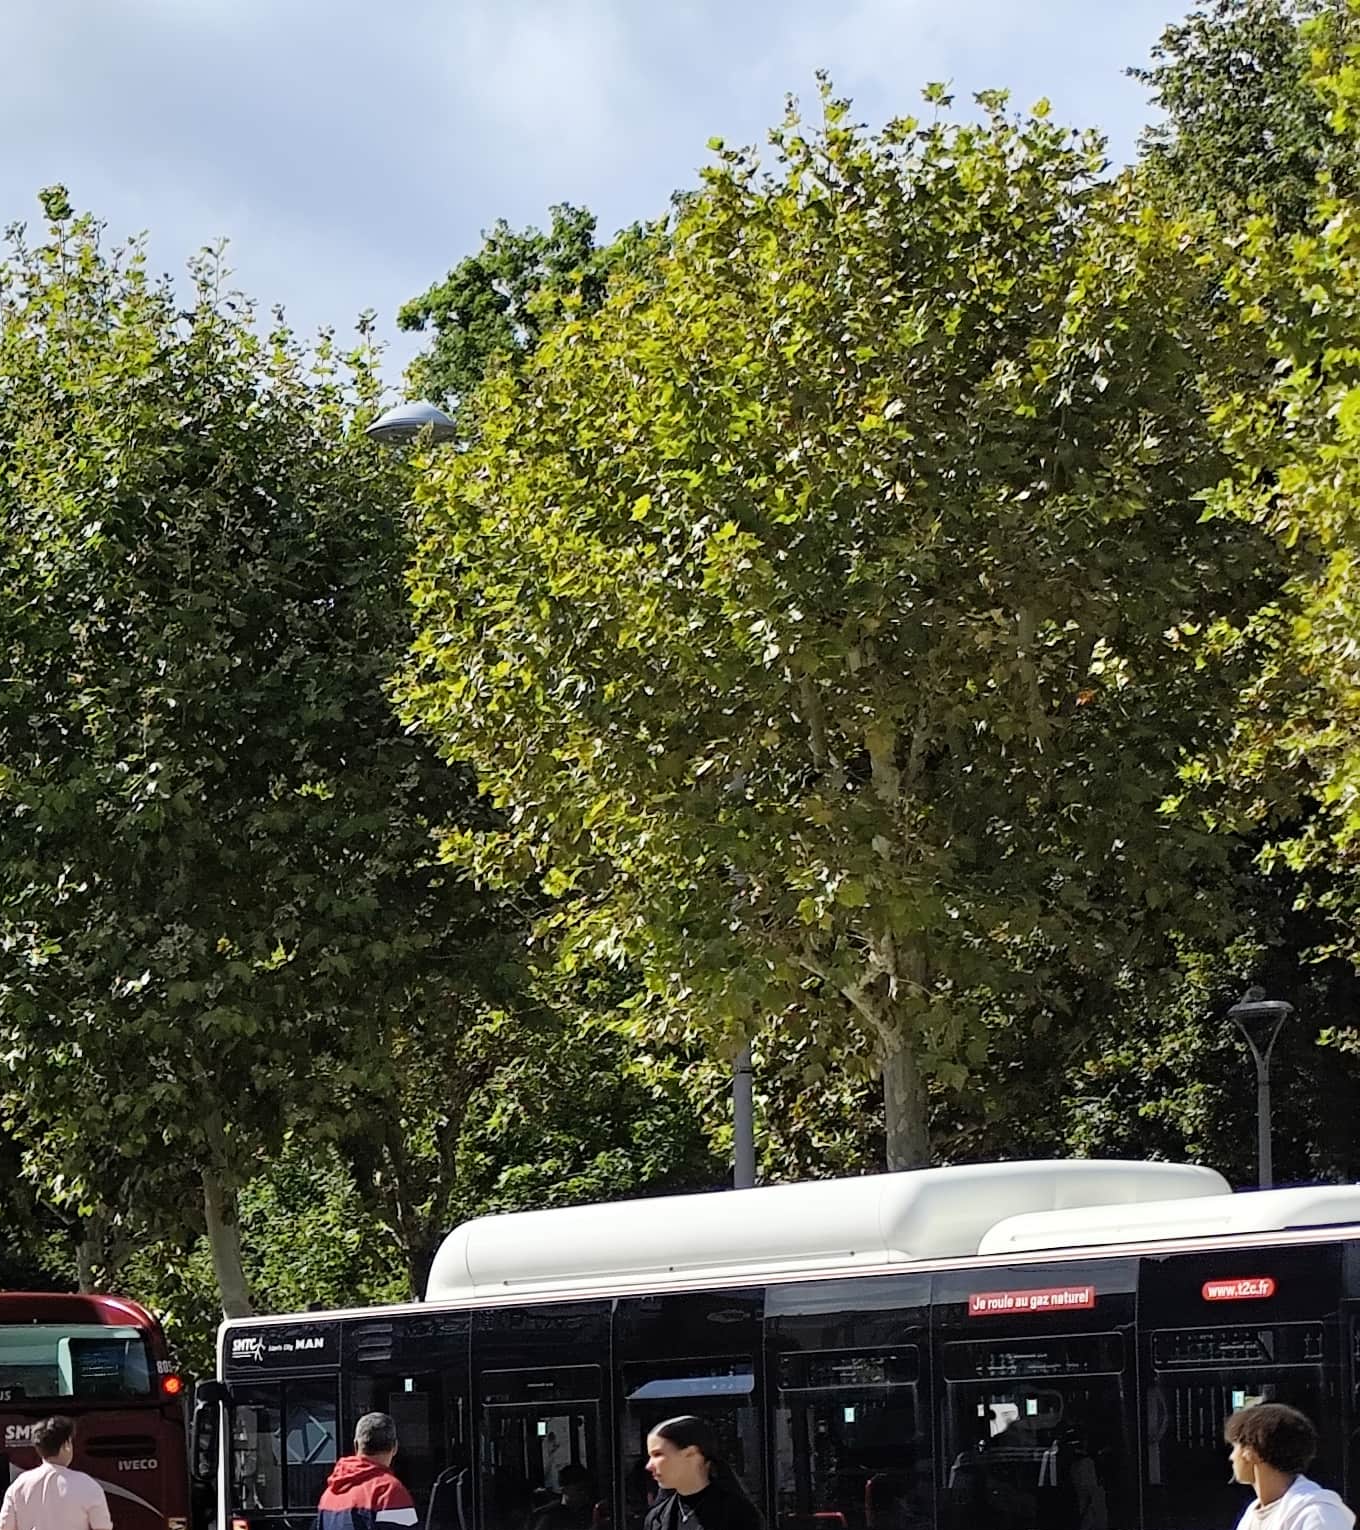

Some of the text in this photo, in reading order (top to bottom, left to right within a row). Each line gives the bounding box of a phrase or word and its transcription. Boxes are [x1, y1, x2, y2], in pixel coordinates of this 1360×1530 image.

[1207, 1281, 1269, 1297] www.t2c.fr
[972, 1289, 1089, 1310] Je roule au gaz naturel
[295, 1337, 324, 1350] MAN
[118, 1459, 158, 1471] IVECO
